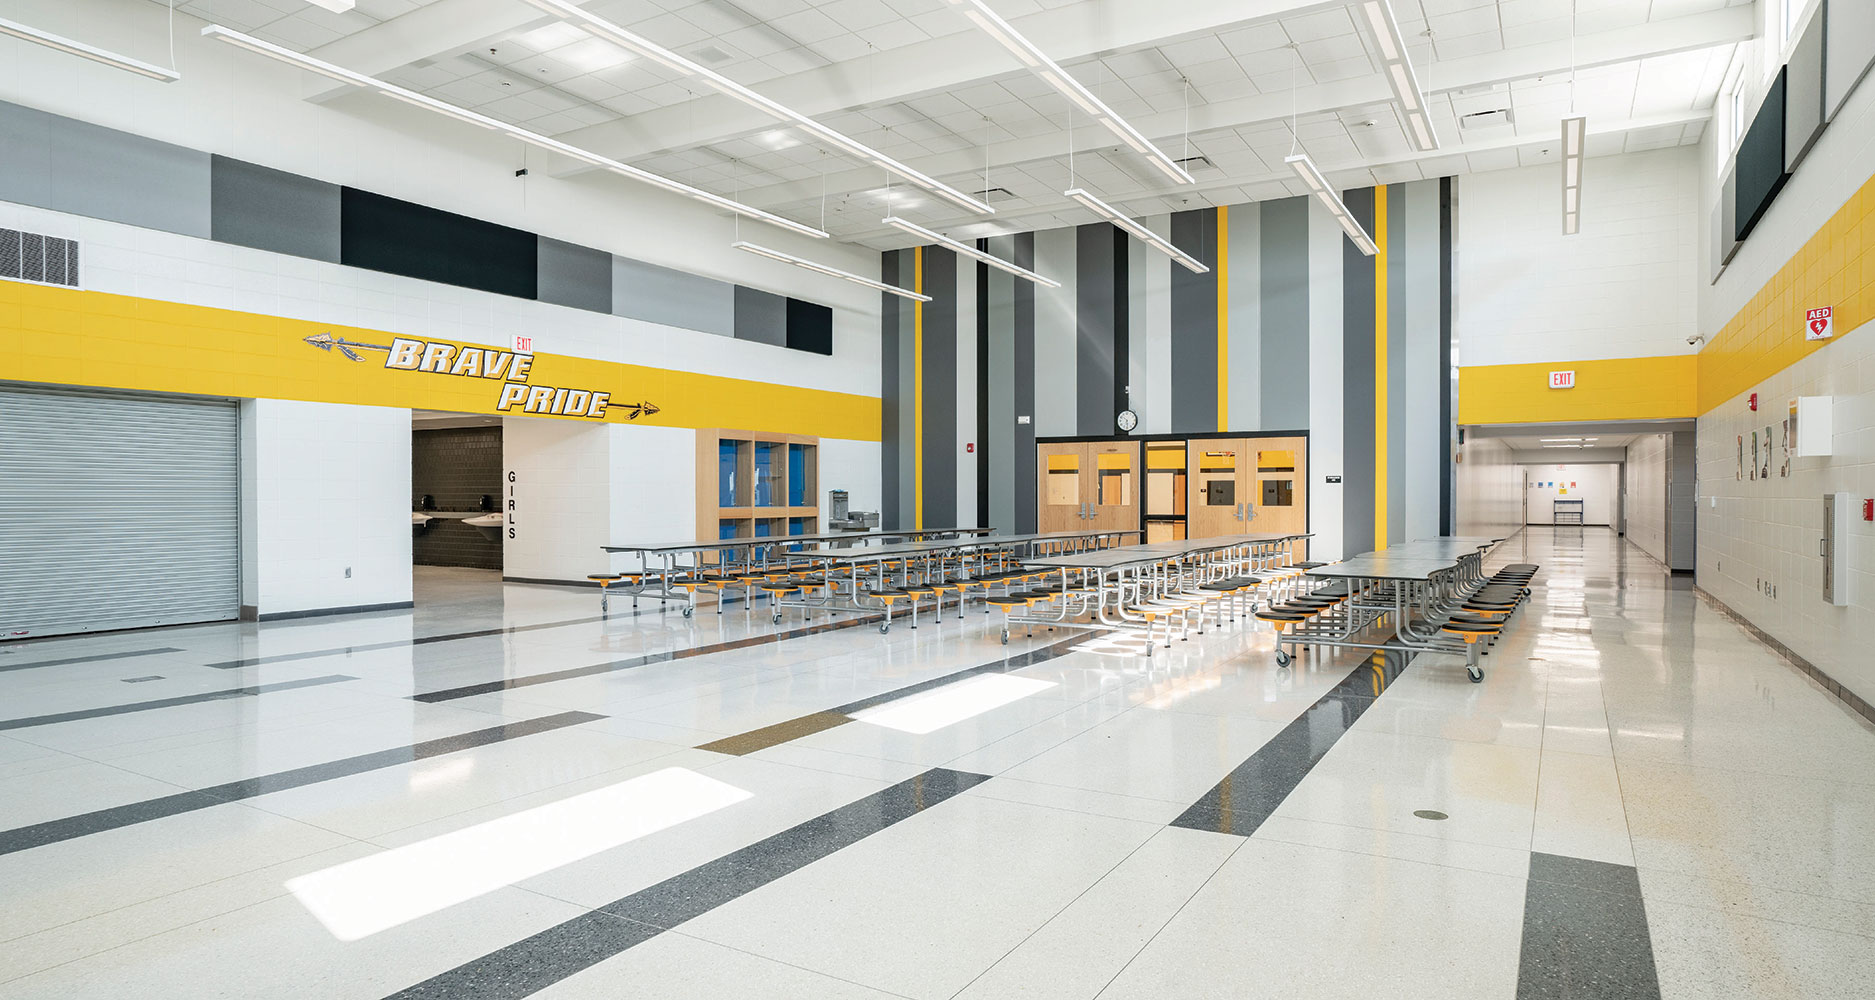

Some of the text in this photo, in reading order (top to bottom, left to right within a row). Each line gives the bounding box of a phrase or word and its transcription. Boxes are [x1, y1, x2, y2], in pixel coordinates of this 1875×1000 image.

[1809, 308, 1829, 319] AED
[517, 336, 531, 351] EXIT
[385, 337, 534, 382] BRAVE
[1553, 372, 1571, 385] EXIT
[497, 382, 611, 418] PRIDE
